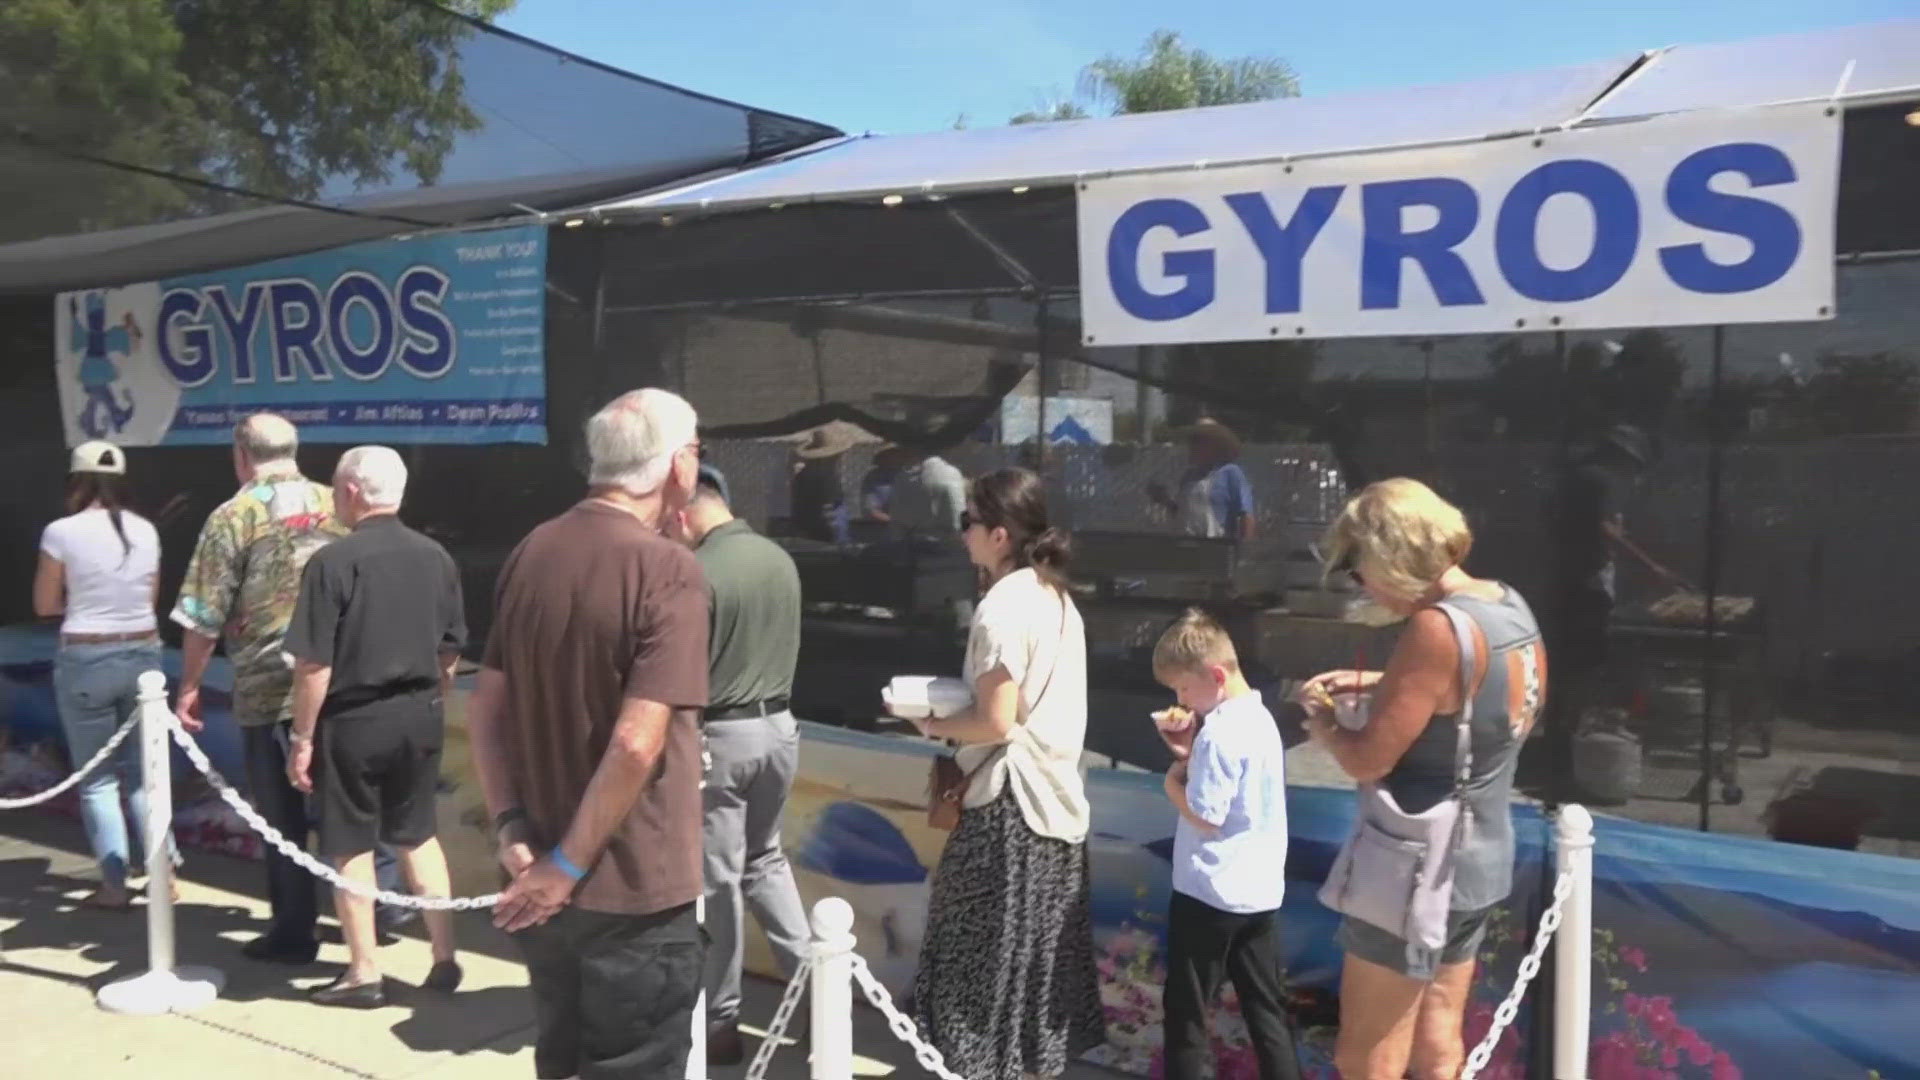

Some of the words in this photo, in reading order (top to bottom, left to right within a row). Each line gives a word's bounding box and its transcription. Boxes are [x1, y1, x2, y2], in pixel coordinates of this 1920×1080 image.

[456, 244, 502, 263] THANK
[1107, 142, 1803, 322] GYROS
[157, 265, 456, 388] GYROS
[355, 405, 379, 421] Jim
